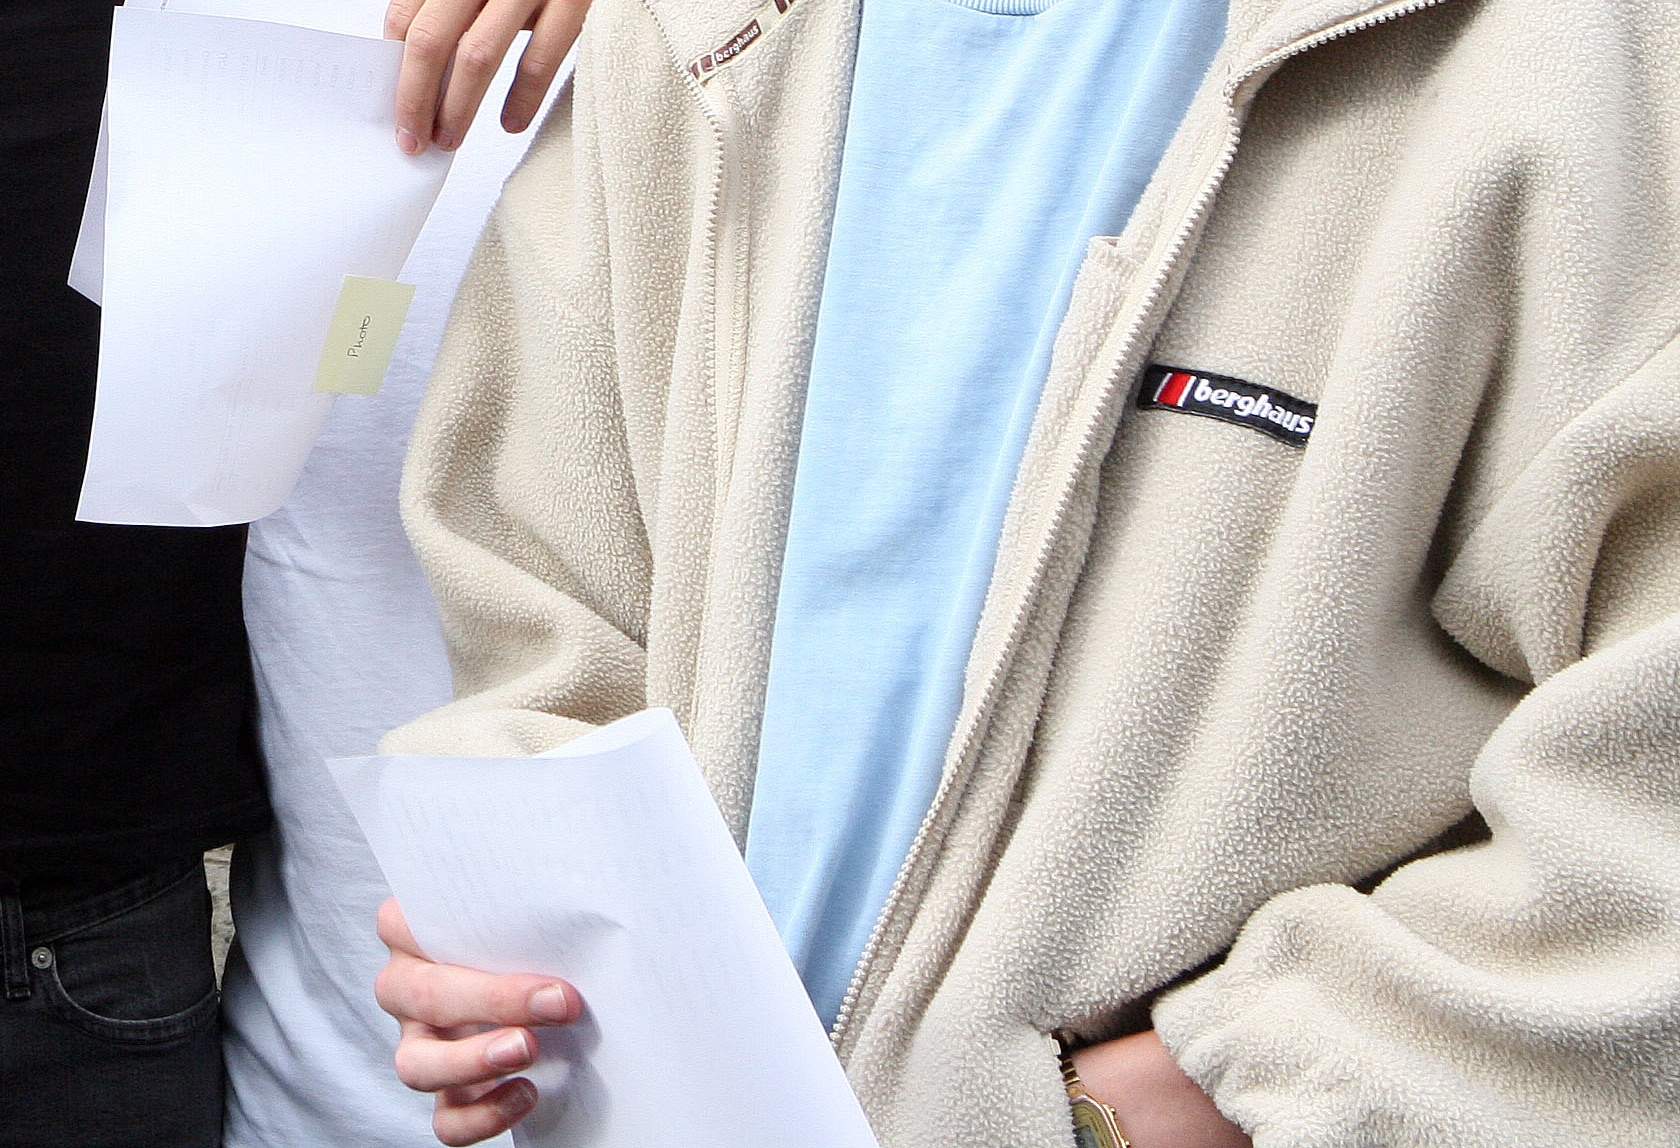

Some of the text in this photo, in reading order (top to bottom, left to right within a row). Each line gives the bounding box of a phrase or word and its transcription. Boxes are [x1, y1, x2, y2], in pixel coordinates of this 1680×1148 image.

[715, 23, 760, 62] berghaus
[346, 315, 371, 358] Photo
[1193, 378, 1314, 435] berghaus
